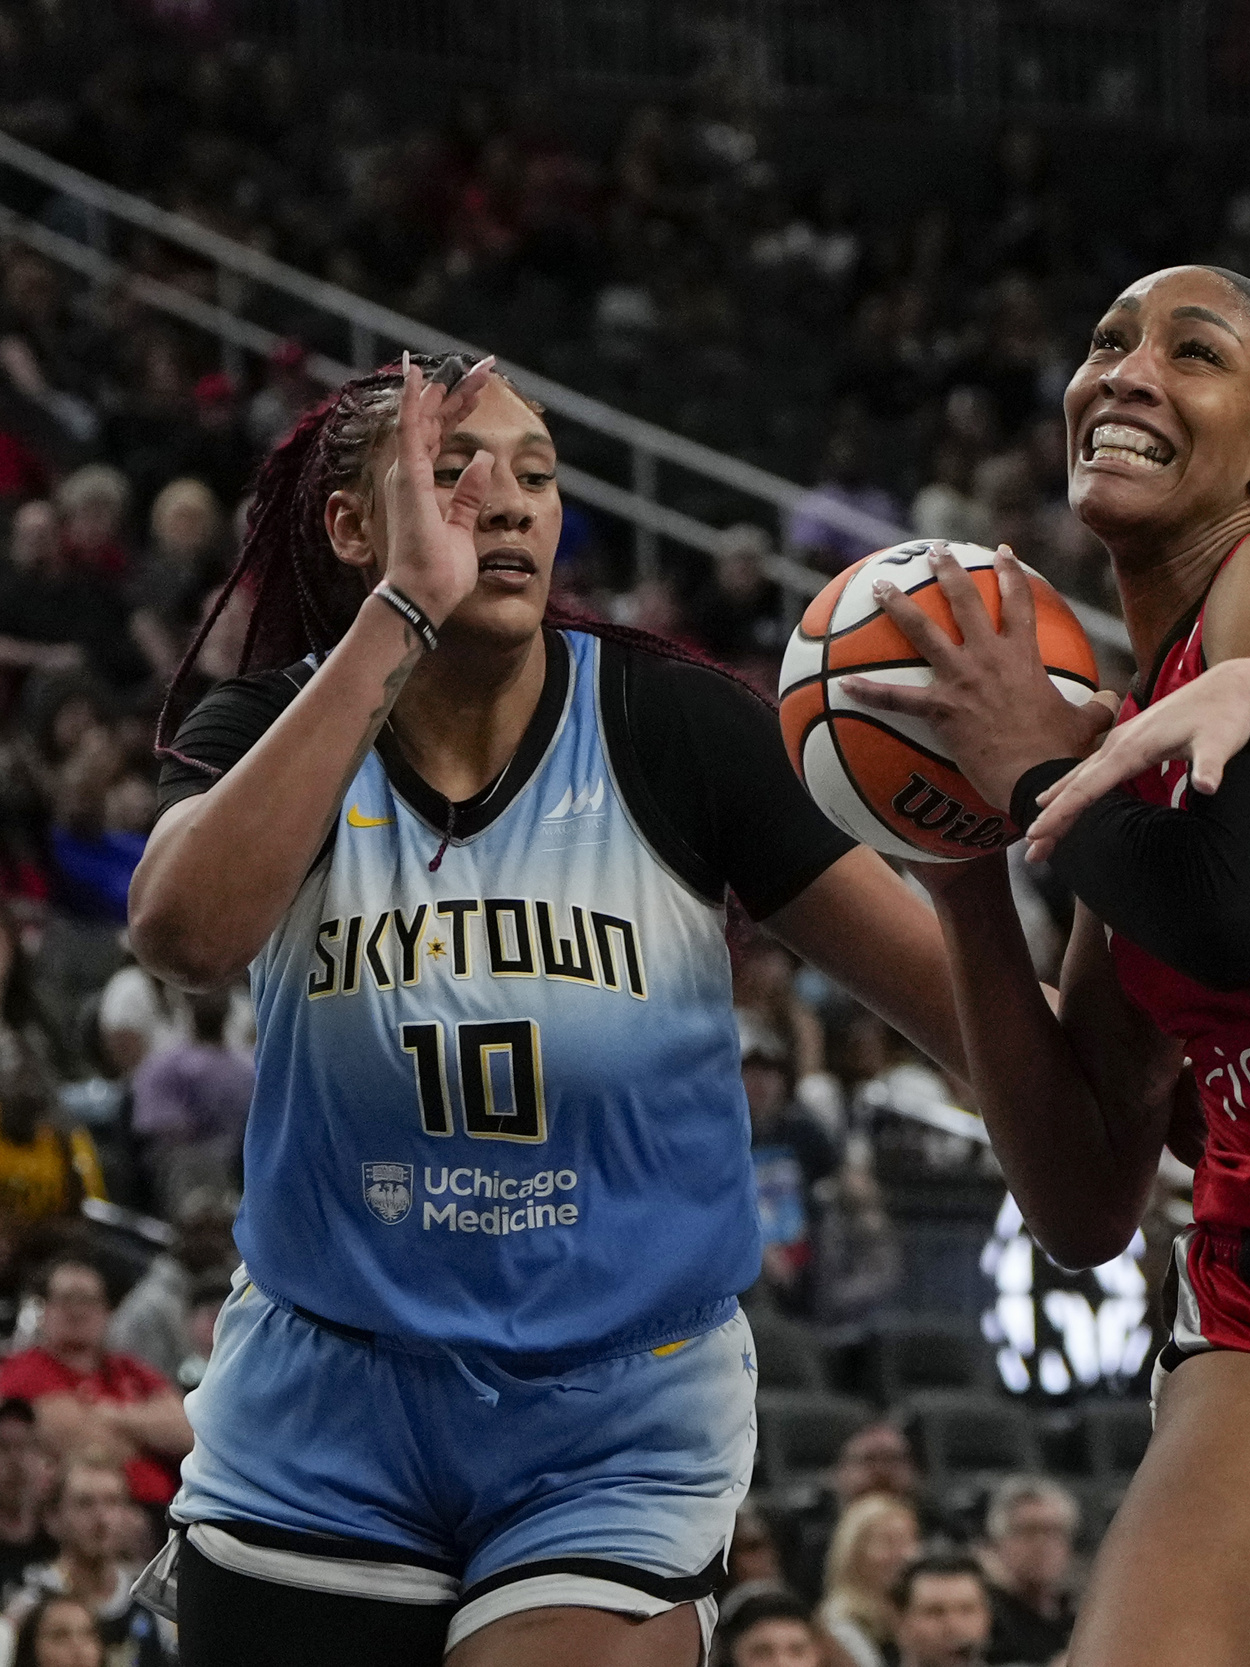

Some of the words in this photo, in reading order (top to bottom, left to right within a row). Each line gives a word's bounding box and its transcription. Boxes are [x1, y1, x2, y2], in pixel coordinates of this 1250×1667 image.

[399, 1017, 548, 1144] 10
[424, 1166, 578, 1200] UChicago
[422, 1199, 579, 1236] Medicine
